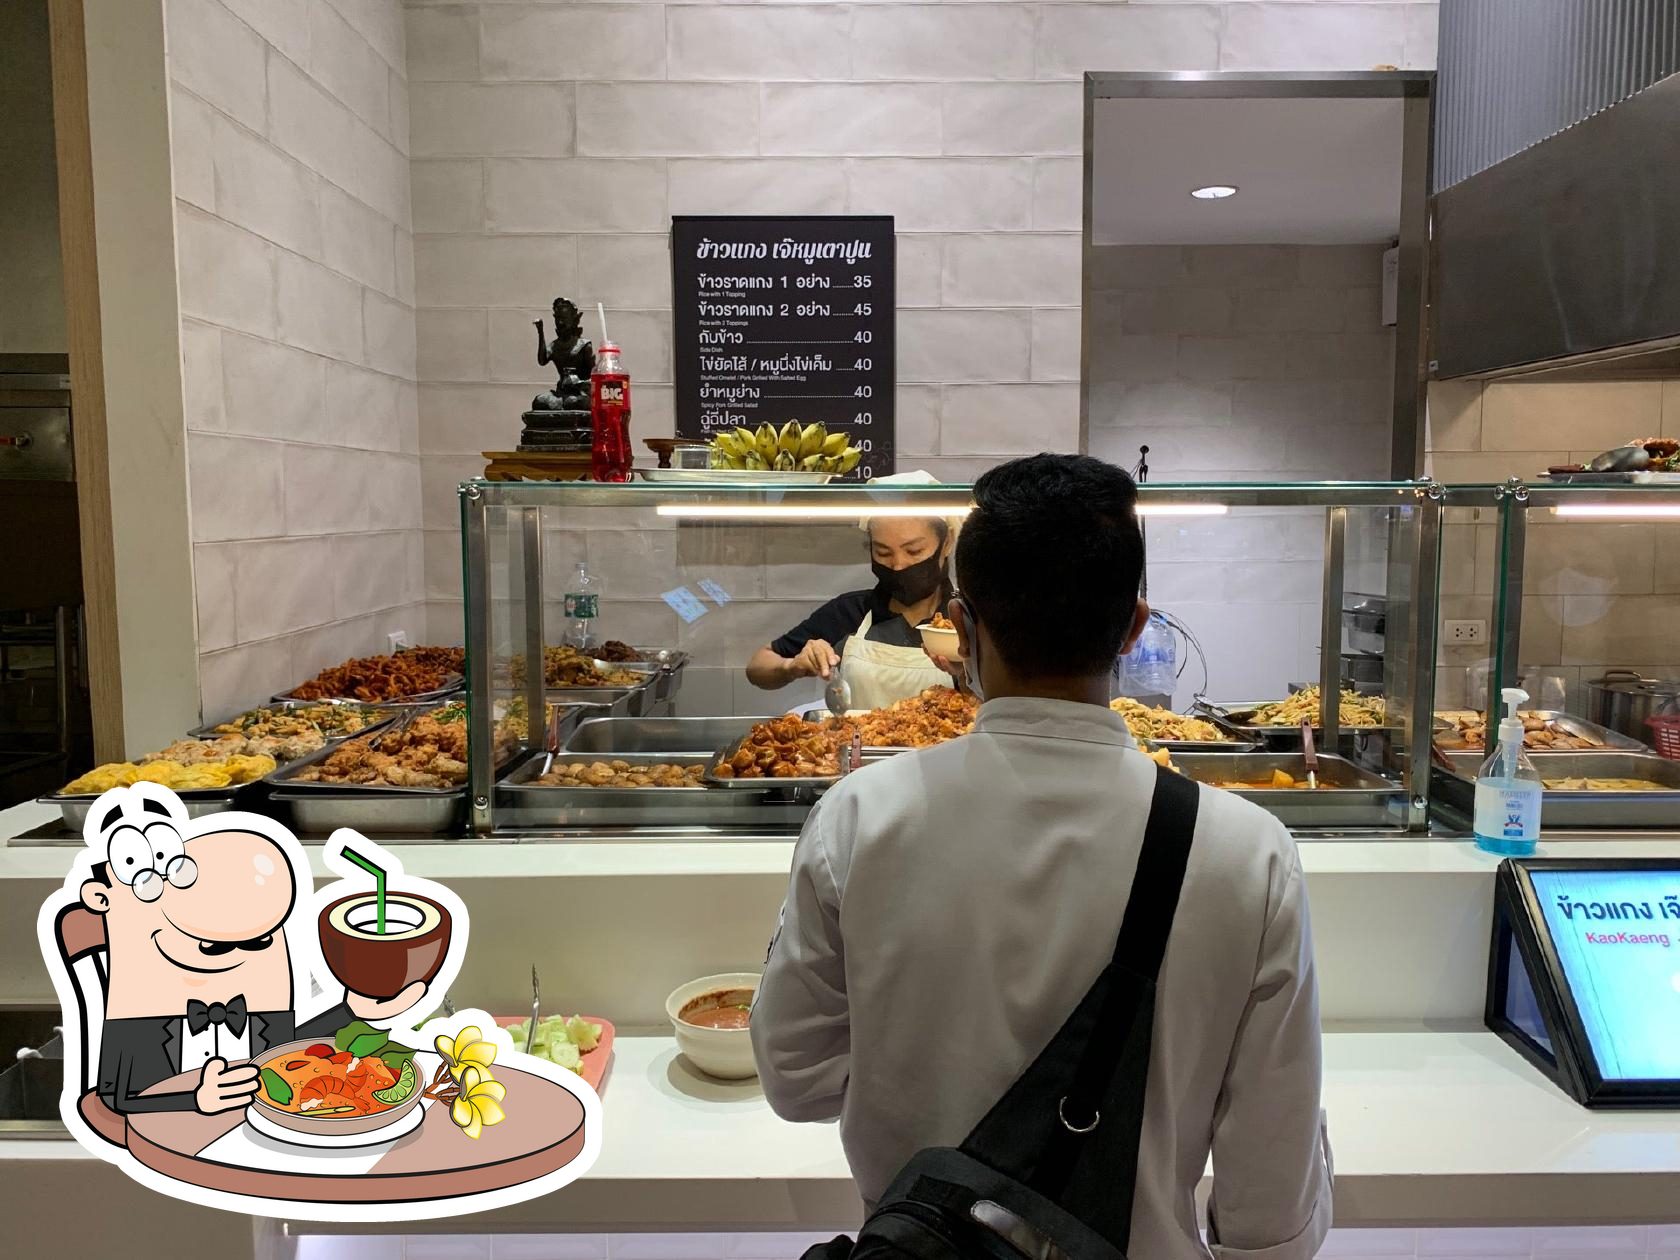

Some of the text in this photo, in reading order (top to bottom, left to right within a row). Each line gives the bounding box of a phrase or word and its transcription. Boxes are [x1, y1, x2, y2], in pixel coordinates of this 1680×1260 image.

[696, 238, 768, 259] ข้าวแกง
[698, 273, 872, 289] ข้าวราดแกง 1 อย่าง 35
[698, 301, 872, 317] ข้าวราดแกง 2 อย่าง 45
[699, 329, 872, 344] กับข้าว 40
[700, 356, 747, 371] ไข่ยัดไส้
[760, 353, 832, 375] หมูนึ่งไข่เค็ม
[854, 358, 872, 371] 40
[700, 383, 872, 403] ยำหมูย่าง 40
[701, 408, 872, 430] ฉู่ฉี่ปลา 40
[855, 466, 872, 479] 10
[1556, 895, 1653, 920] ข้าวแกง
[1585, 932, 1670, 947] KaoKaeng
